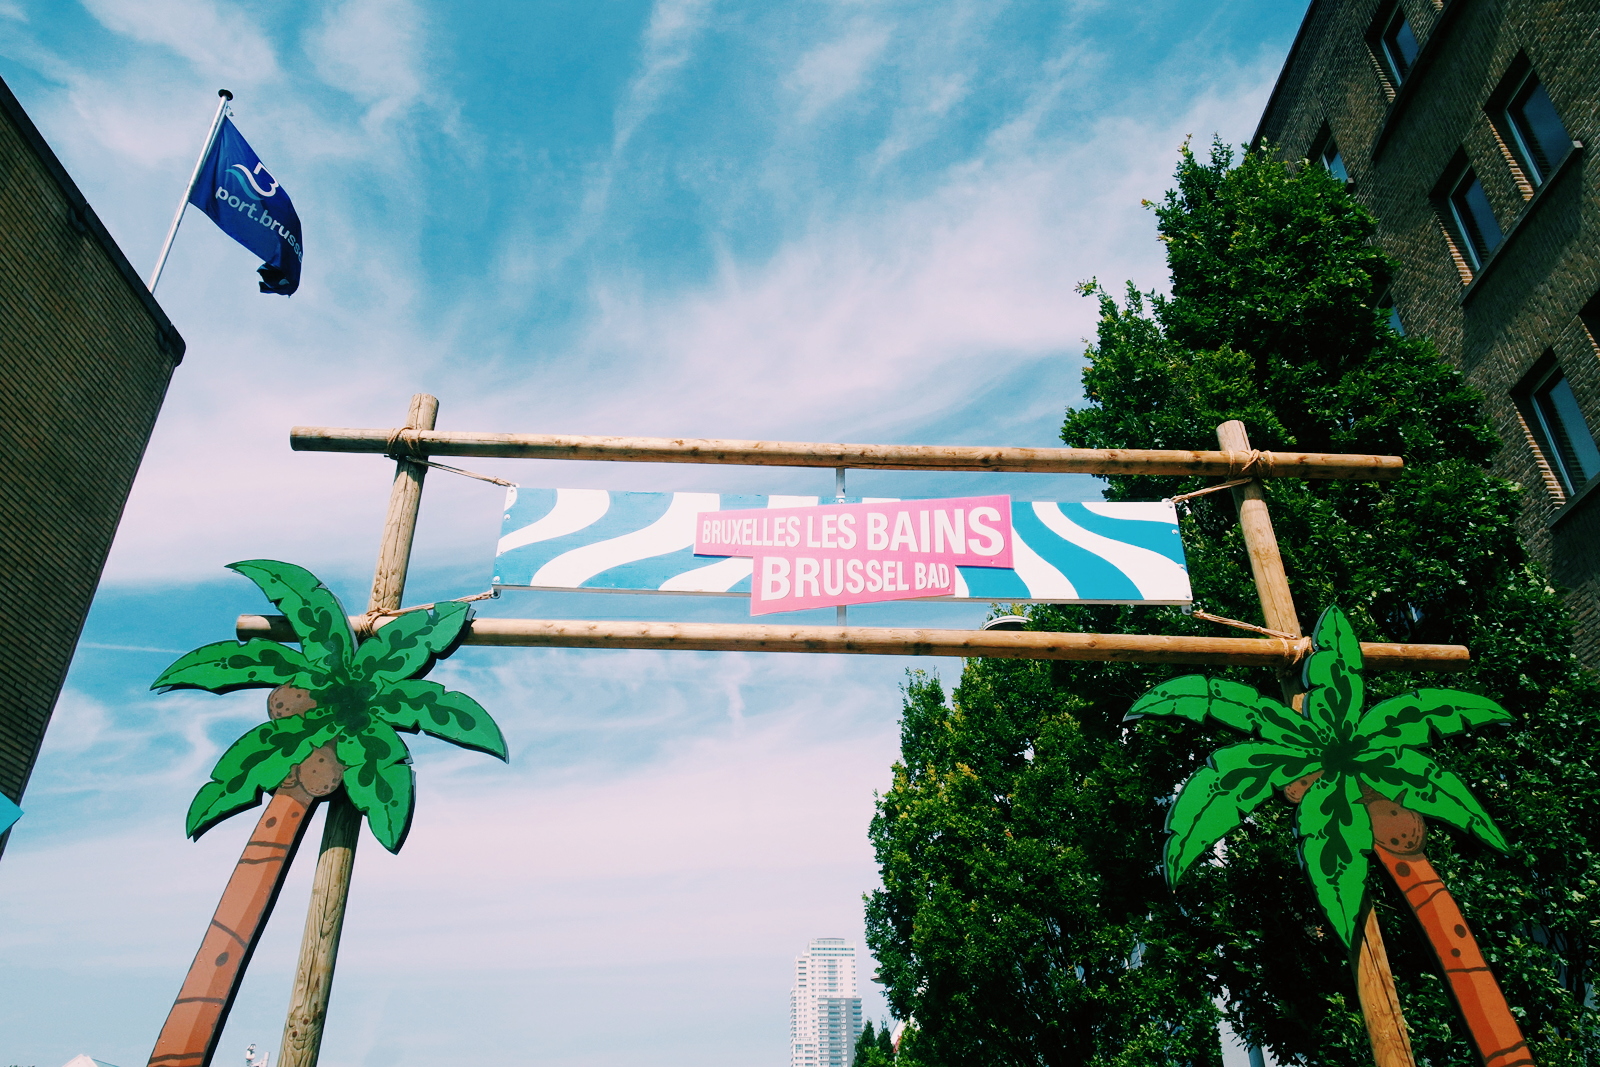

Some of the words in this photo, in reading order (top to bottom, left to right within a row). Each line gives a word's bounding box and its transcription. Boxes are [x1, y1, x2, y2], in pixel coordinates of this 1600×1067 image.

[702, 516, 801, 548] BRUXELLES
[807, 513, 857, 550] LES
[867, 506, 1005, 557] BAINS
[761, 556, 909, 601] BRUSSEL
[915, 562, 950, 589] BAD
